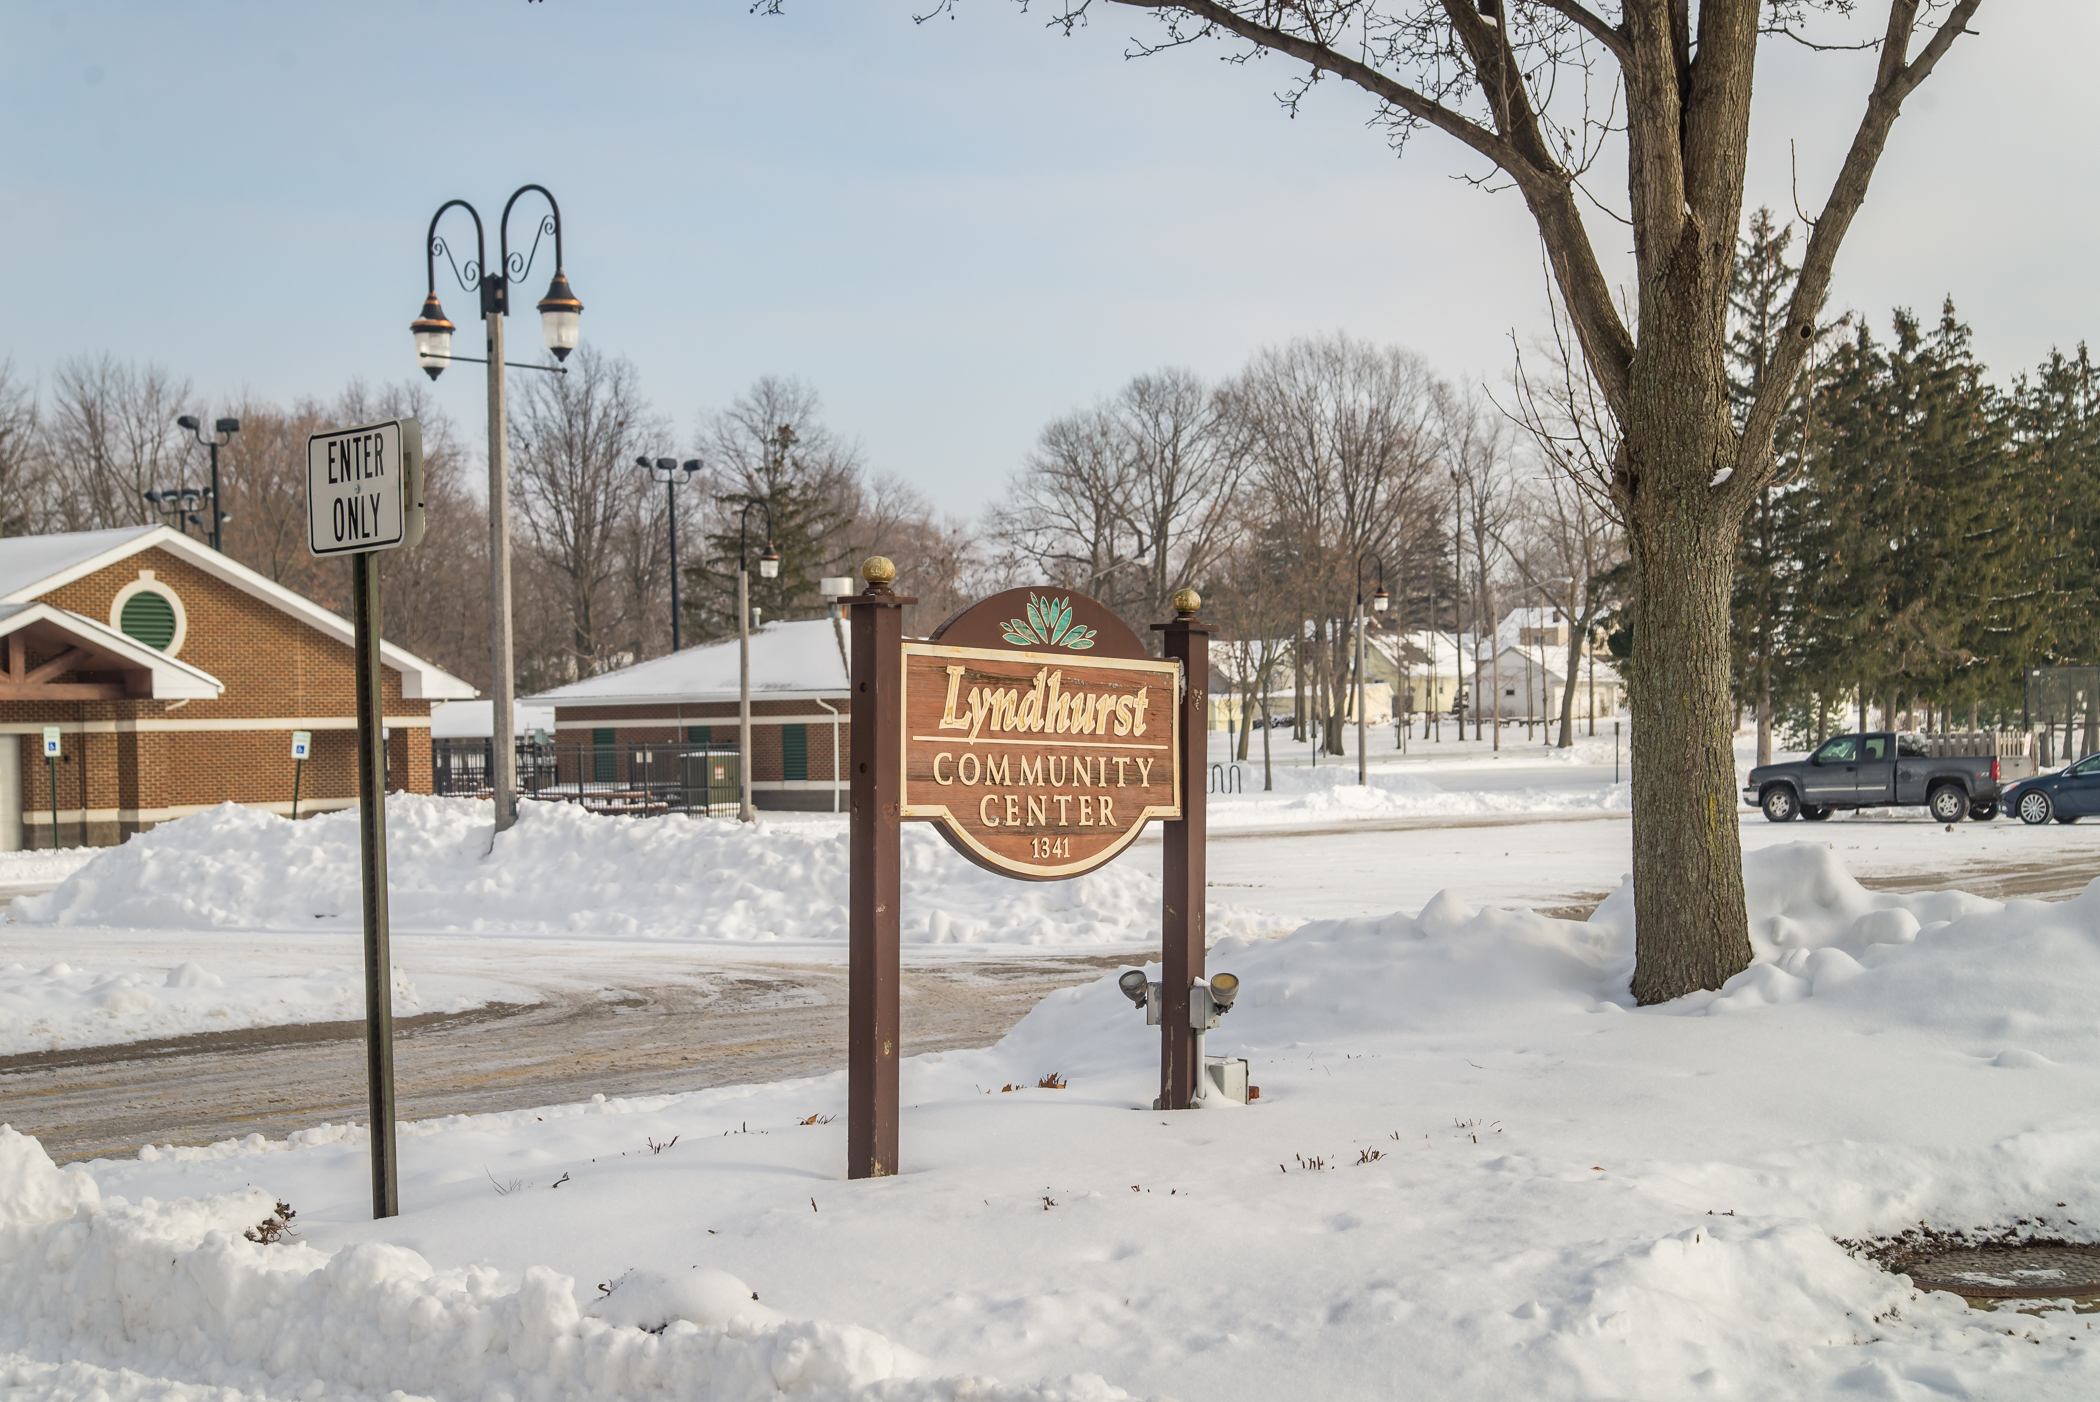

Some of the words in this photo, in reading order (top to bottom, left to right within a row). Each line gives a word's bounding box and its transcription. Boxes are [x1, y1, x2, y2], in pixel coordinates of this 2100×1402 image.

[328, 432, 384, 484] ENTER
[333, 493, 381, 542] ONLY
[938, 665, 1149, 745] Lyndhurst
[933, 752, 1154, 788] COMMUNITY
[979, 794, 1118, 827] CENTER
[1031, 838, 1071, 859] 1341
